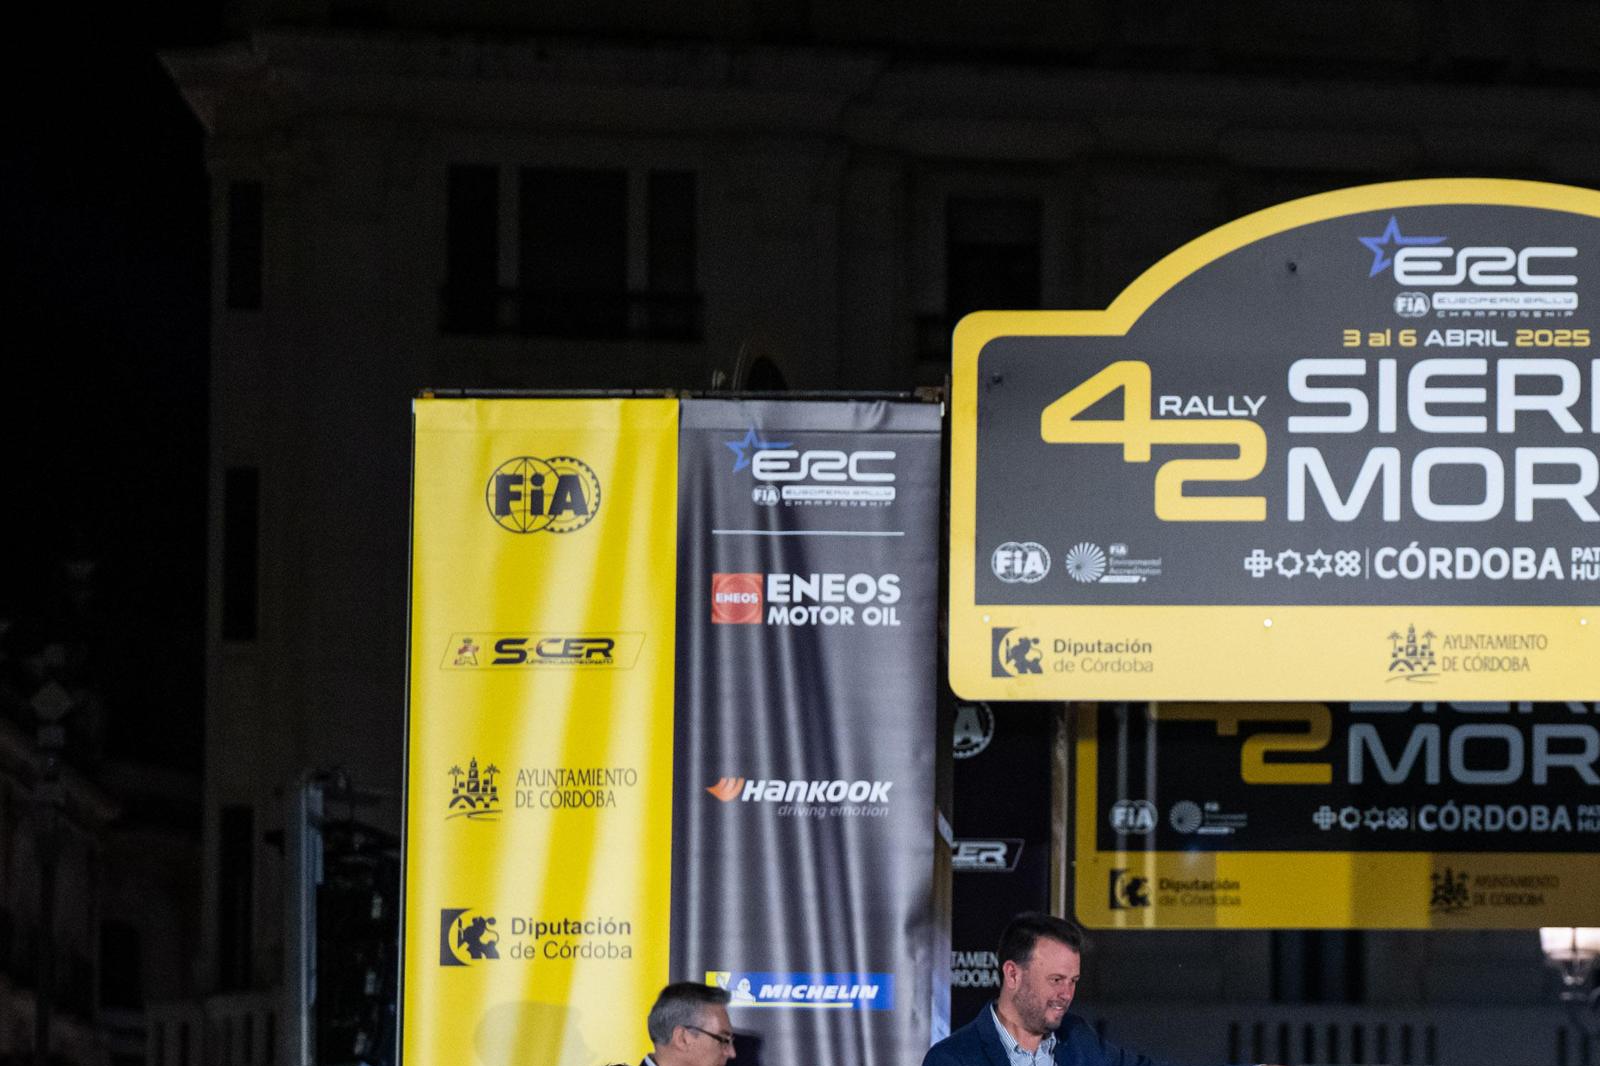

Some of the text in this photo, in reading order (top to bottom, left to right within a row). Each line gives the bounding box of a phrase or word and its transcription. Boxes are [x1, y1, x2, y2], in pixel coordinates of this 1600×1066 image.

[1343, 329, 1591, 347] 3 al 6 ABRIL 2025
[1159, 395, 1267, 417] RALLY
[1374, 541, 1565, 580] CÓRDOBA
[767, 573, 902, 604] ENEOS
[715, 592, 758, 605] ENEOS
[768, 605, 902, 627] MOTOR OIL
[1053, 638, 1153, 655] Diputación
[1443, 634, 1548, 650] AYUNTAMIENTO
[1053, 656, 1154, 673] de Córdoba
[1442, 653, 1531, 672] DE CÓRDOBA
[516, 767, 638, 787] AYUNTAMIENTO
[515, 786, 617, 808] DE CÓRDOBA
[777, 804, 889, 819] driving emotion
[1419, 801, 1572, 832] CÓRDOBA
[1158, 877, 1241, 892] Diputación
[510, 916, 632, 941] Diputación
[510, 938, 633, 960] de Córdoba
[759, 983, 879, 1001] MICHELIN
